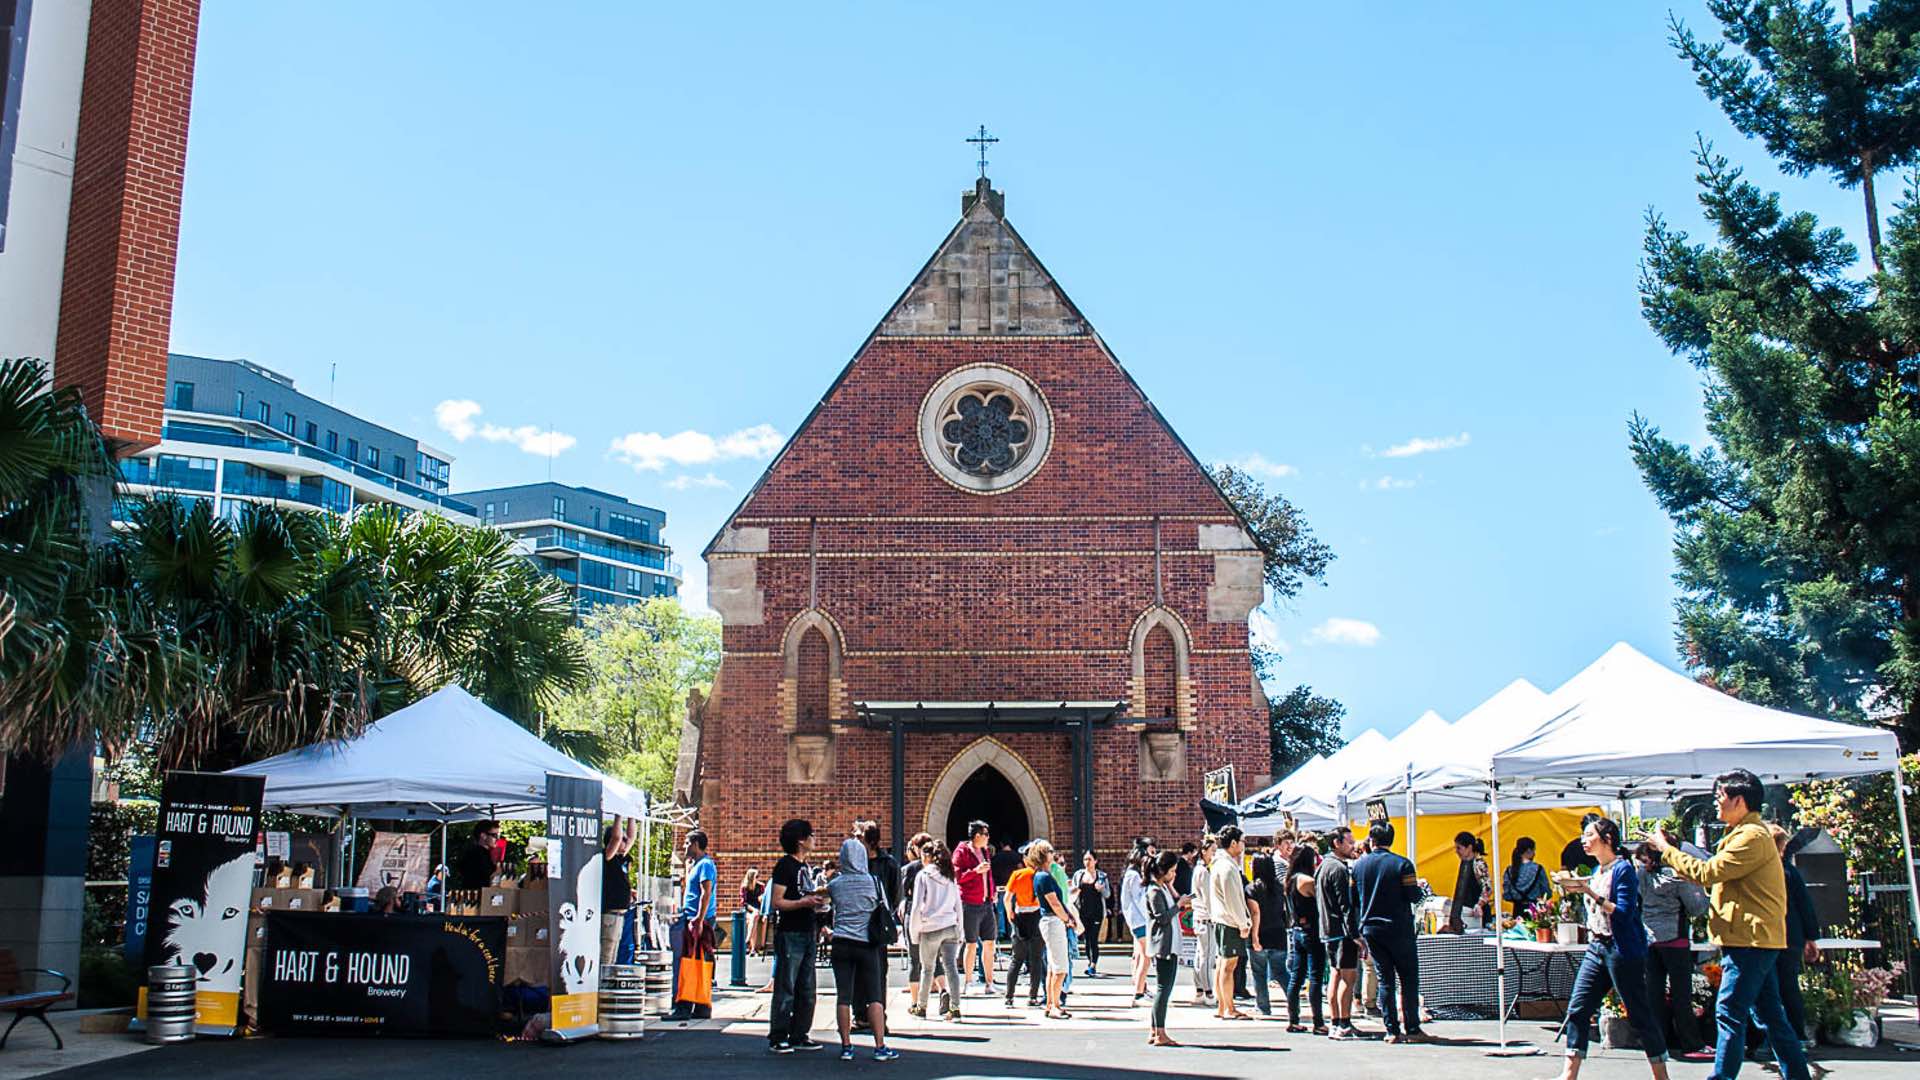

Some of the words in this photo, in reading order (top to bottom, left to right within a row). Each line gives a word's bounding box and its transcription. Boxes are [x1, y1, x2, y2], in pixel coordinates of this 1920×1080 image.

[165, 811, 196, 833] HART
[197, 813, 208, 834] &
[211, 814, 253, 836] HOUND
[550, 814, 567, 836] HART
[568, 815, 575, 837] &
[576, 816, 599, 838] HOUND
[274, 949, 319, 982] HART
[325, 952, 339, 983] &
[347, 952, 410, 985] HOUND
[367, 986, 407, 999] Brewery
